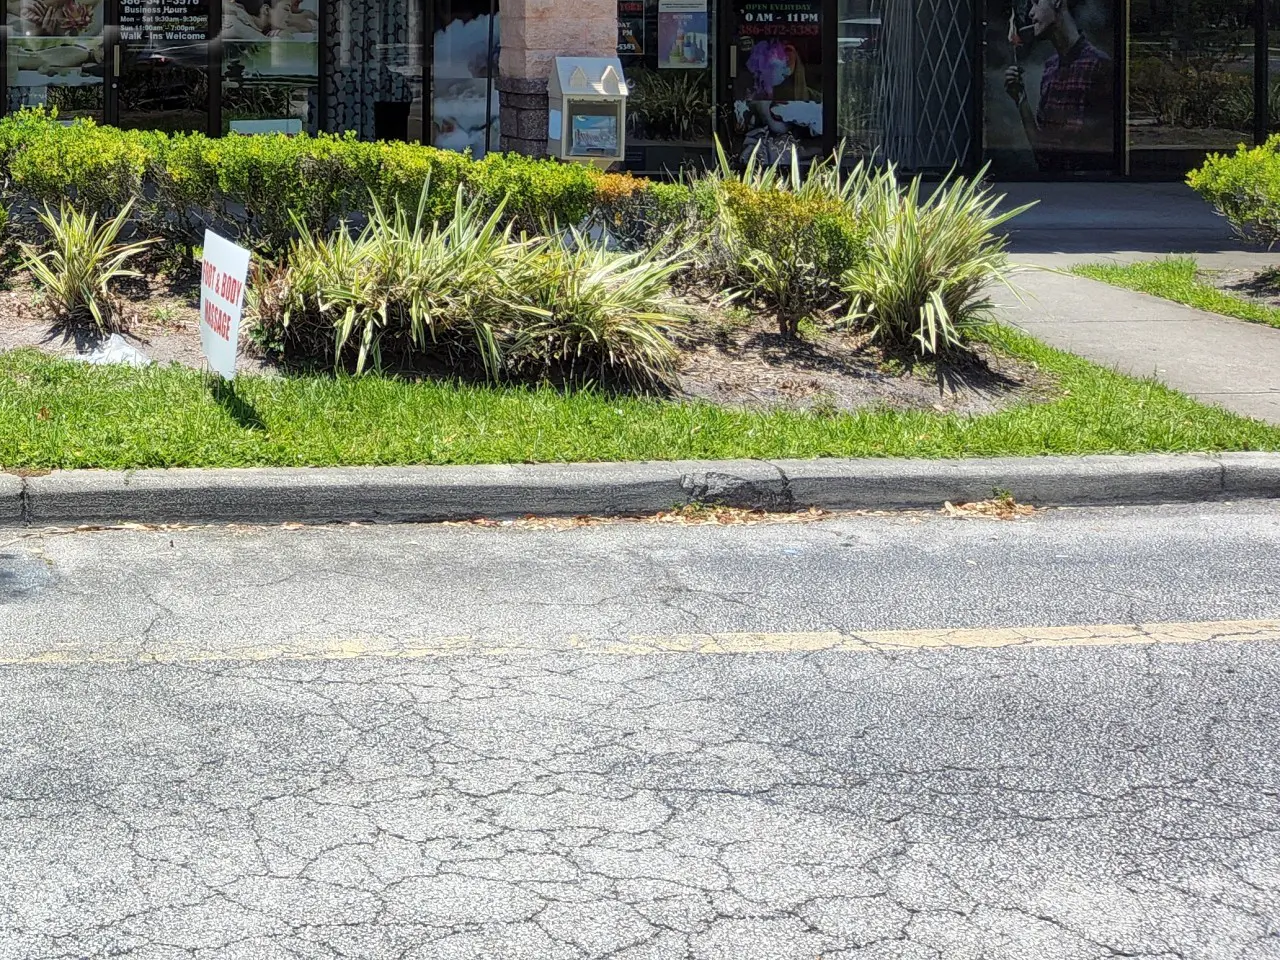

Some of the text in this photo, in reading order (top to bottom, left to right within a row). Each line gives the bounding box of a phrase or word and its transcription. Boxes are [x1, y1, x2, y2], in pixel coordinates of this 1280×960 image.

[124, 6, 187, 14] Business Hours
[745, 3, 767, 11] OPEN
[756, 13, 773, 21] AM
[800, 13, 818, 21] PM
[120, 32, 141, 40] Walk
[165, 32, 206, 40] Welcome
[202, 260, 242, 307] FOOT & BODY
[204, 297, 232, 341] MASSAGE
